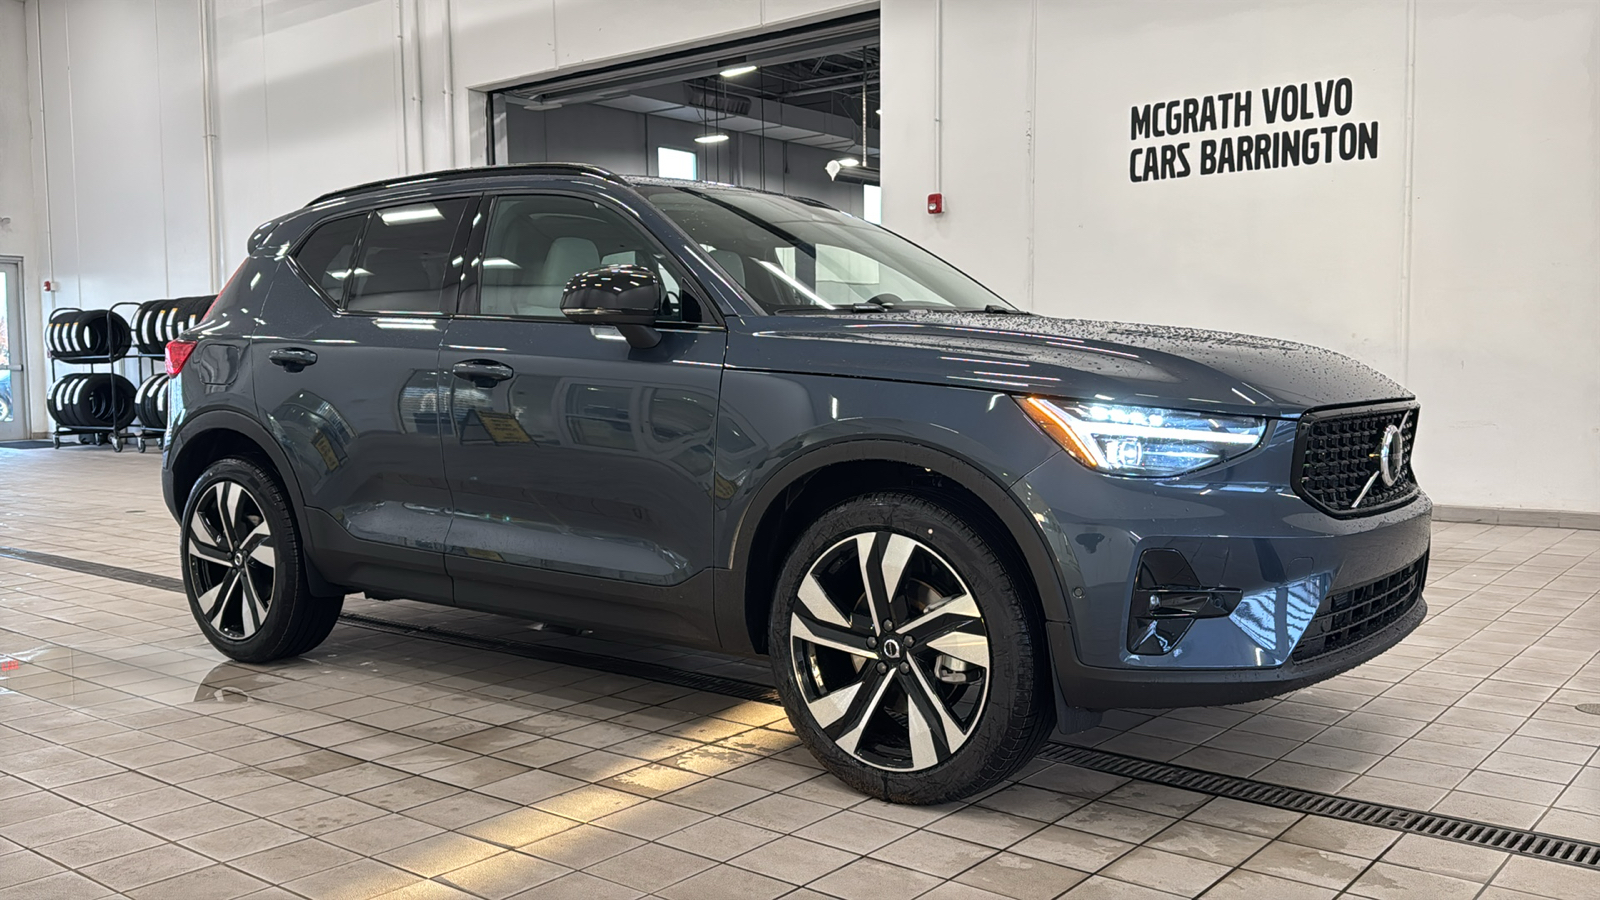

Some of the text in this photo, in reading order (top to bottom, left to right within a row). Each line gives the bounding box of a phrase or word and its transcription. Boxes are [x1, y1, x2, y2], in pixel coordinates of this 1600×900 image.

[1130, 77, 1353, 141] MCGRATH VOLVO
[1129, 121, 1379, 183] CARS BARRINGTON
